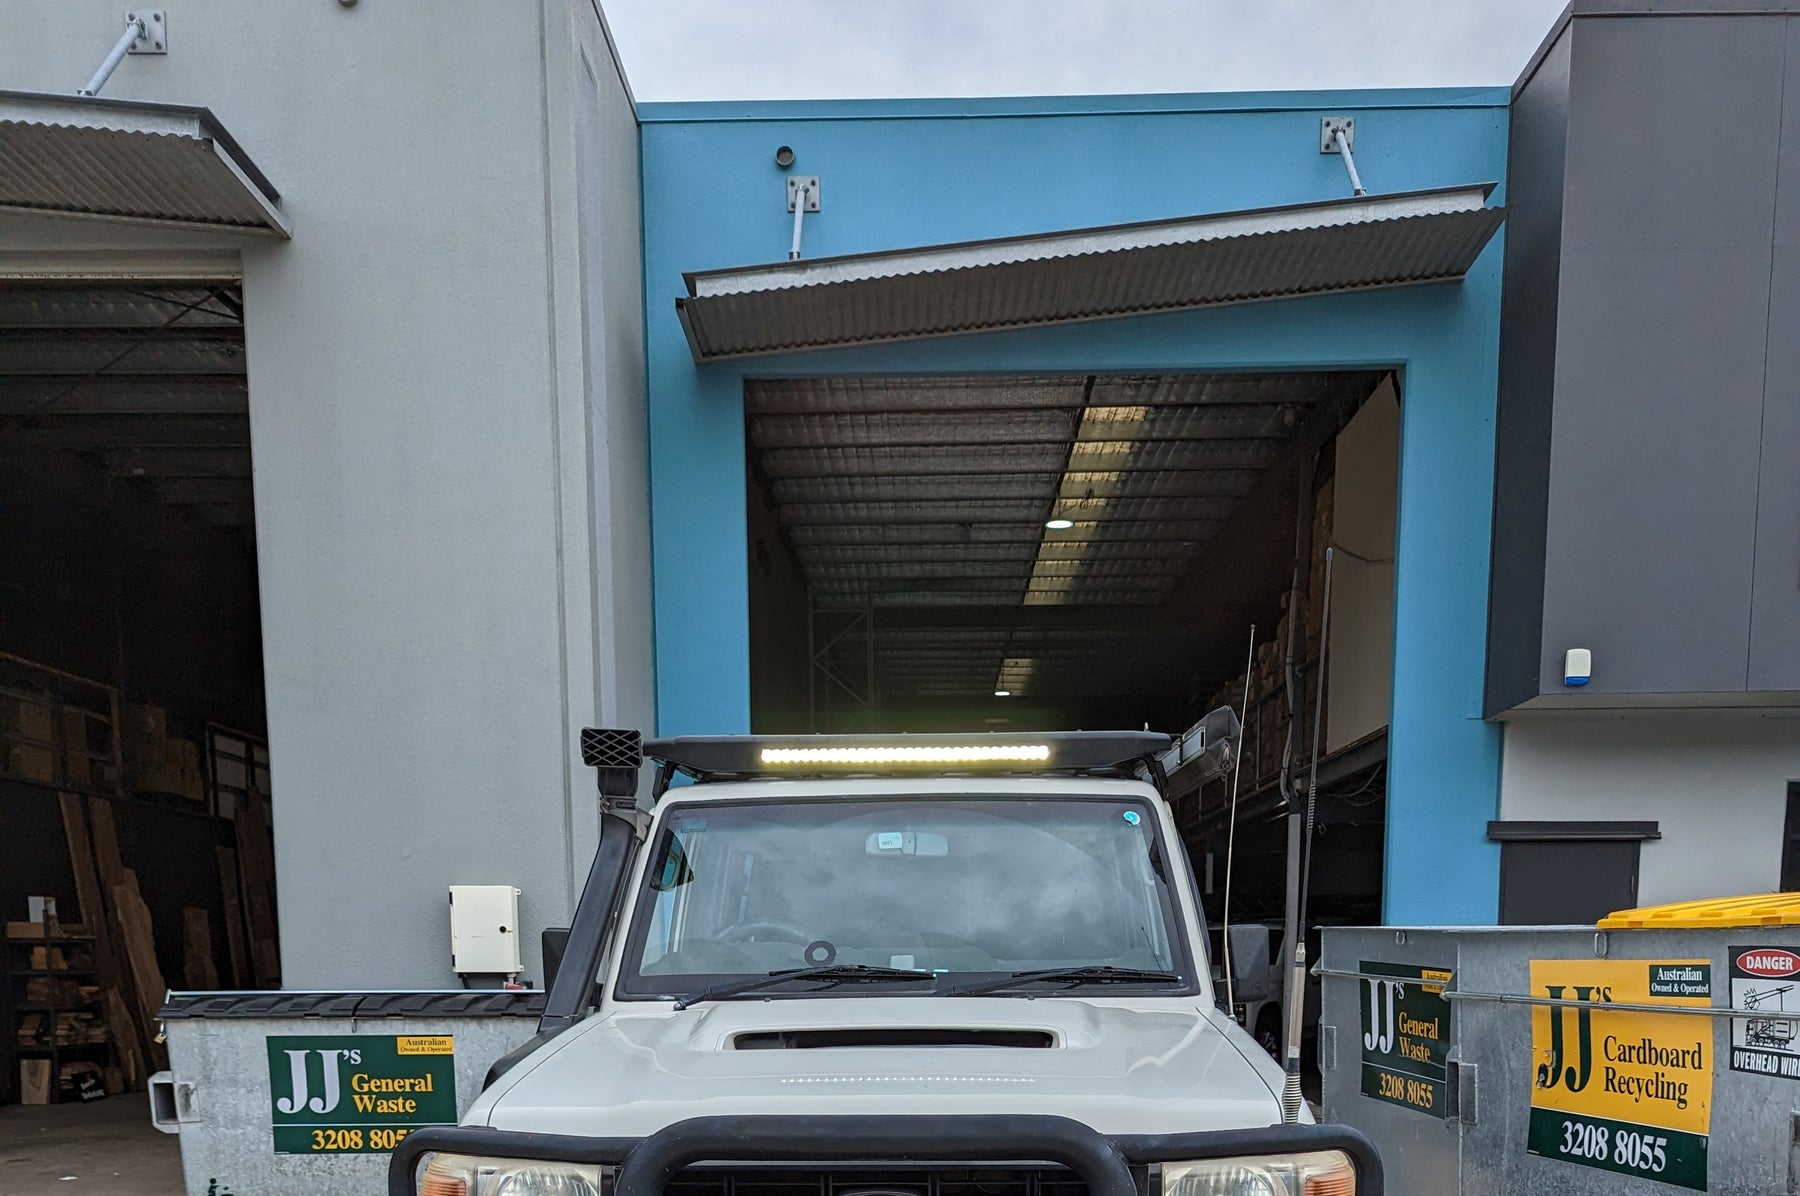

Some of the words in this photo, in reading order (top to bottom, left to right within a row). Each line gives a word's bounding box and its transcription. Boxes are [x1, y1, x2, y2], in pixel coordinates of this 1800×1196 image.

[1746, 955, 1793, 971] DANGER
[1656, 967, 1703, 982] Australian
[1651, 982, 1672, 993] Owned
[1673, 983, 1679, 993] &
[1680, 983, 1709, 995] Operated
[1398, 1011, 1439, 1040] General
[405, 1037, 447, 1046] Australian
[1398, 1036, 1431, 1063] Waste
[1603, 1035, 1703, 1070] Cardboard
[1733, 1050, 1779, 1074] OVERHEAD
[351, 1073, 434, 1093] General
[1378, 1072, 1405, 1101] 3208
[1407, 1080, 1434, 1109] 8055
[1603, 1066, 1689, 1110] Recycling
[352, 1094, 417, 1114] Waste
[311, 1129, 364, 1150] 3208
[369, 1129, 416, 1150] 805
[1559, 1120, 1609, 1161] 3208
[1613, 1130, 1668, 1173] 8055
